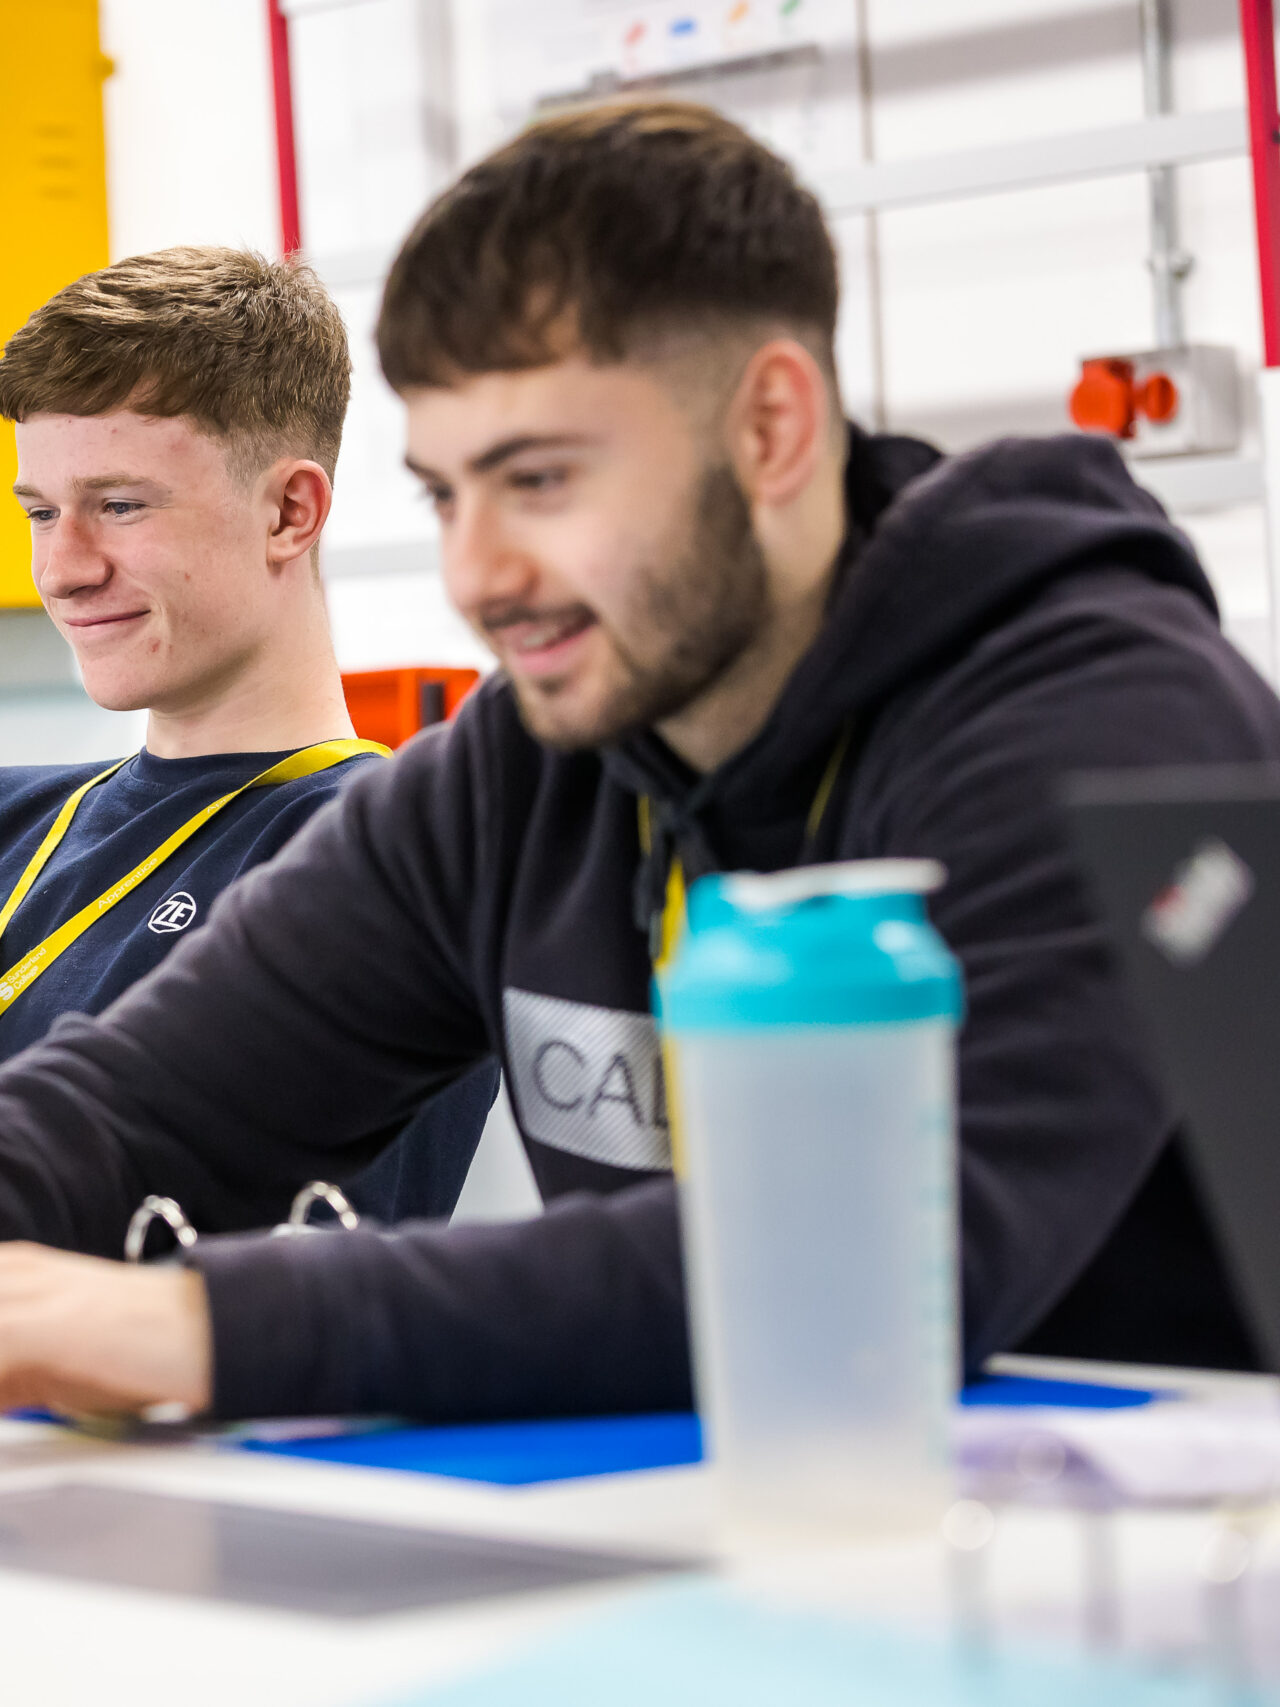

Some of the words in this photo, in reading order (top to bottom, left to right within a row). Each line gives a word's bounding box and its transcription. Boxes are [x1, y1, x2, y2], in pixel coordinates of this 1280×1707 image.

[98, 857, 158, 910] Apprentice
[151, 899, 196, 930] ZF
[7, 947, 47, 983] Sunderland
